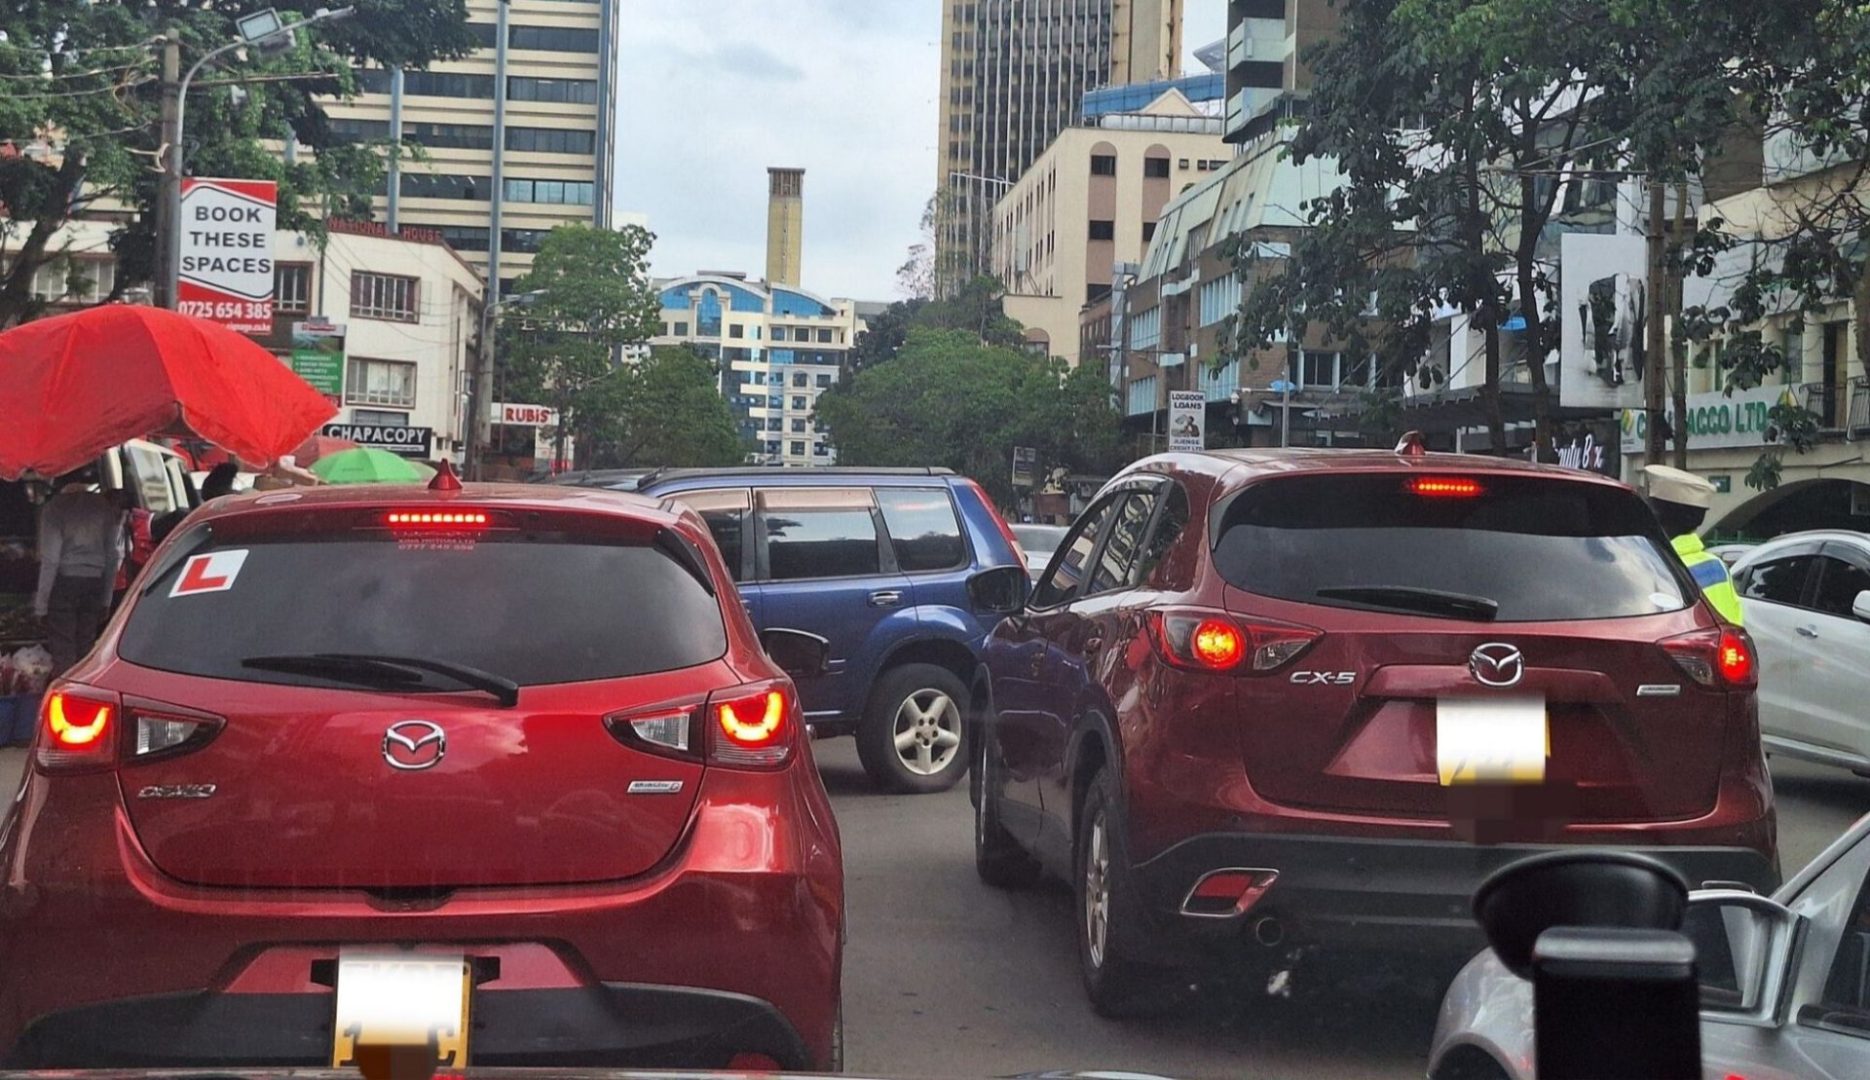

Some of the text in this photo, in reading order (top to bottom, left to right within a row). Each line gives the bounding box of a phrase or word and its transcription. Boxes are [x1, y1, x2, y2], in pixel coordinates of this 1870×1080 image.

[195, 206, 262, 223] BOOK
[189, 231, 266, 248] THESE
[403, 227, 441, 241] HOUSE
[182, 256, 271, 274] SPACES
[178, 301, 271, 319] 0725 654 385
[1171, 393, 1204, 401] LOGBOOK
[1174, 402, 1202, 410] LOANS
[1735, 401, 1767, 433] LTD
[328, 426, 425, 443] CHAPACOPY
[176, 556, 229, 593] L
[1289, 671, 1357, 685] CX-5
